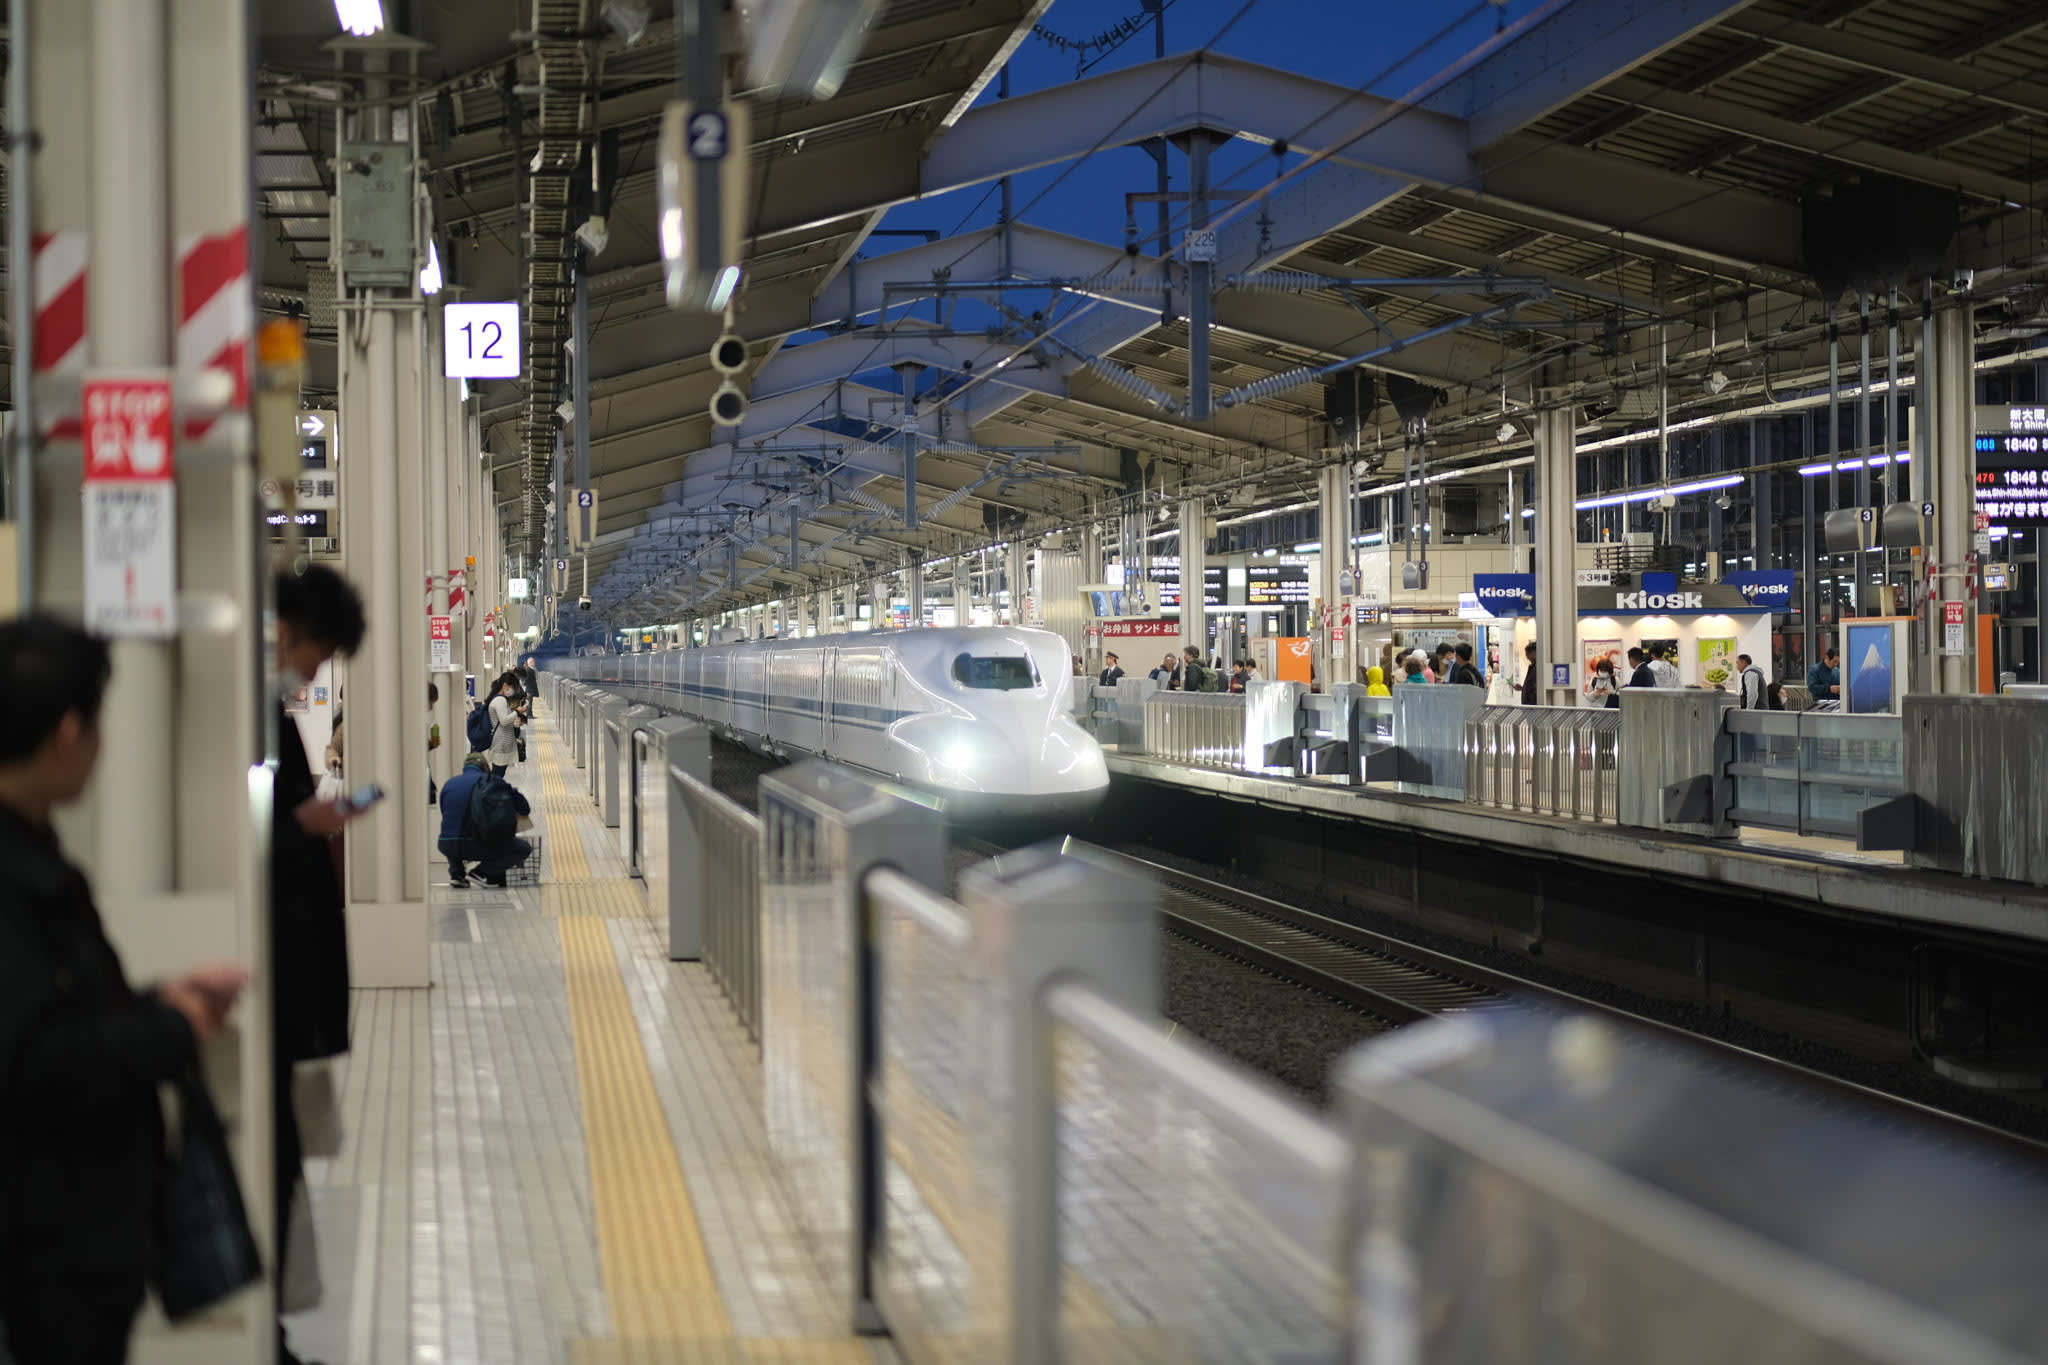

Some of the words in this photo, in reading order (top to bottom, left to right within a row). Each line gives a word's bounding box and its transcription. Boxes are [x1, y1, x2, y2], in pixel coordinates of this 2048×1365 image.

[691, 113, 723, 157] 2
[460, 321, 503, 359] 12
[2010, 408, 2045, 421] 新大阪
[2024, 419, 2048, 431] Shin-
[2004, 437, 2038, 452] 18:40
[2004, 470, 2037, 486] 18:46
[580, 493, 590, 505] 2
[1924, 504, 1932, 515] 2
[1863, 511, 1871, 521] 3
[1421, 562, 1426, 570] 3
[1355, 571, 1361, 579] 4
[513, 582, 523, 592] 12
[1479, 587, 1526, 598] Kiosk
[1742, 584, 1789, 594] Kiosk
[1616, 590, 1703, 609] Kiosk
[1103, 624, 1131, 634] お弁当
[1134, 624, 1161, 634] サンド
